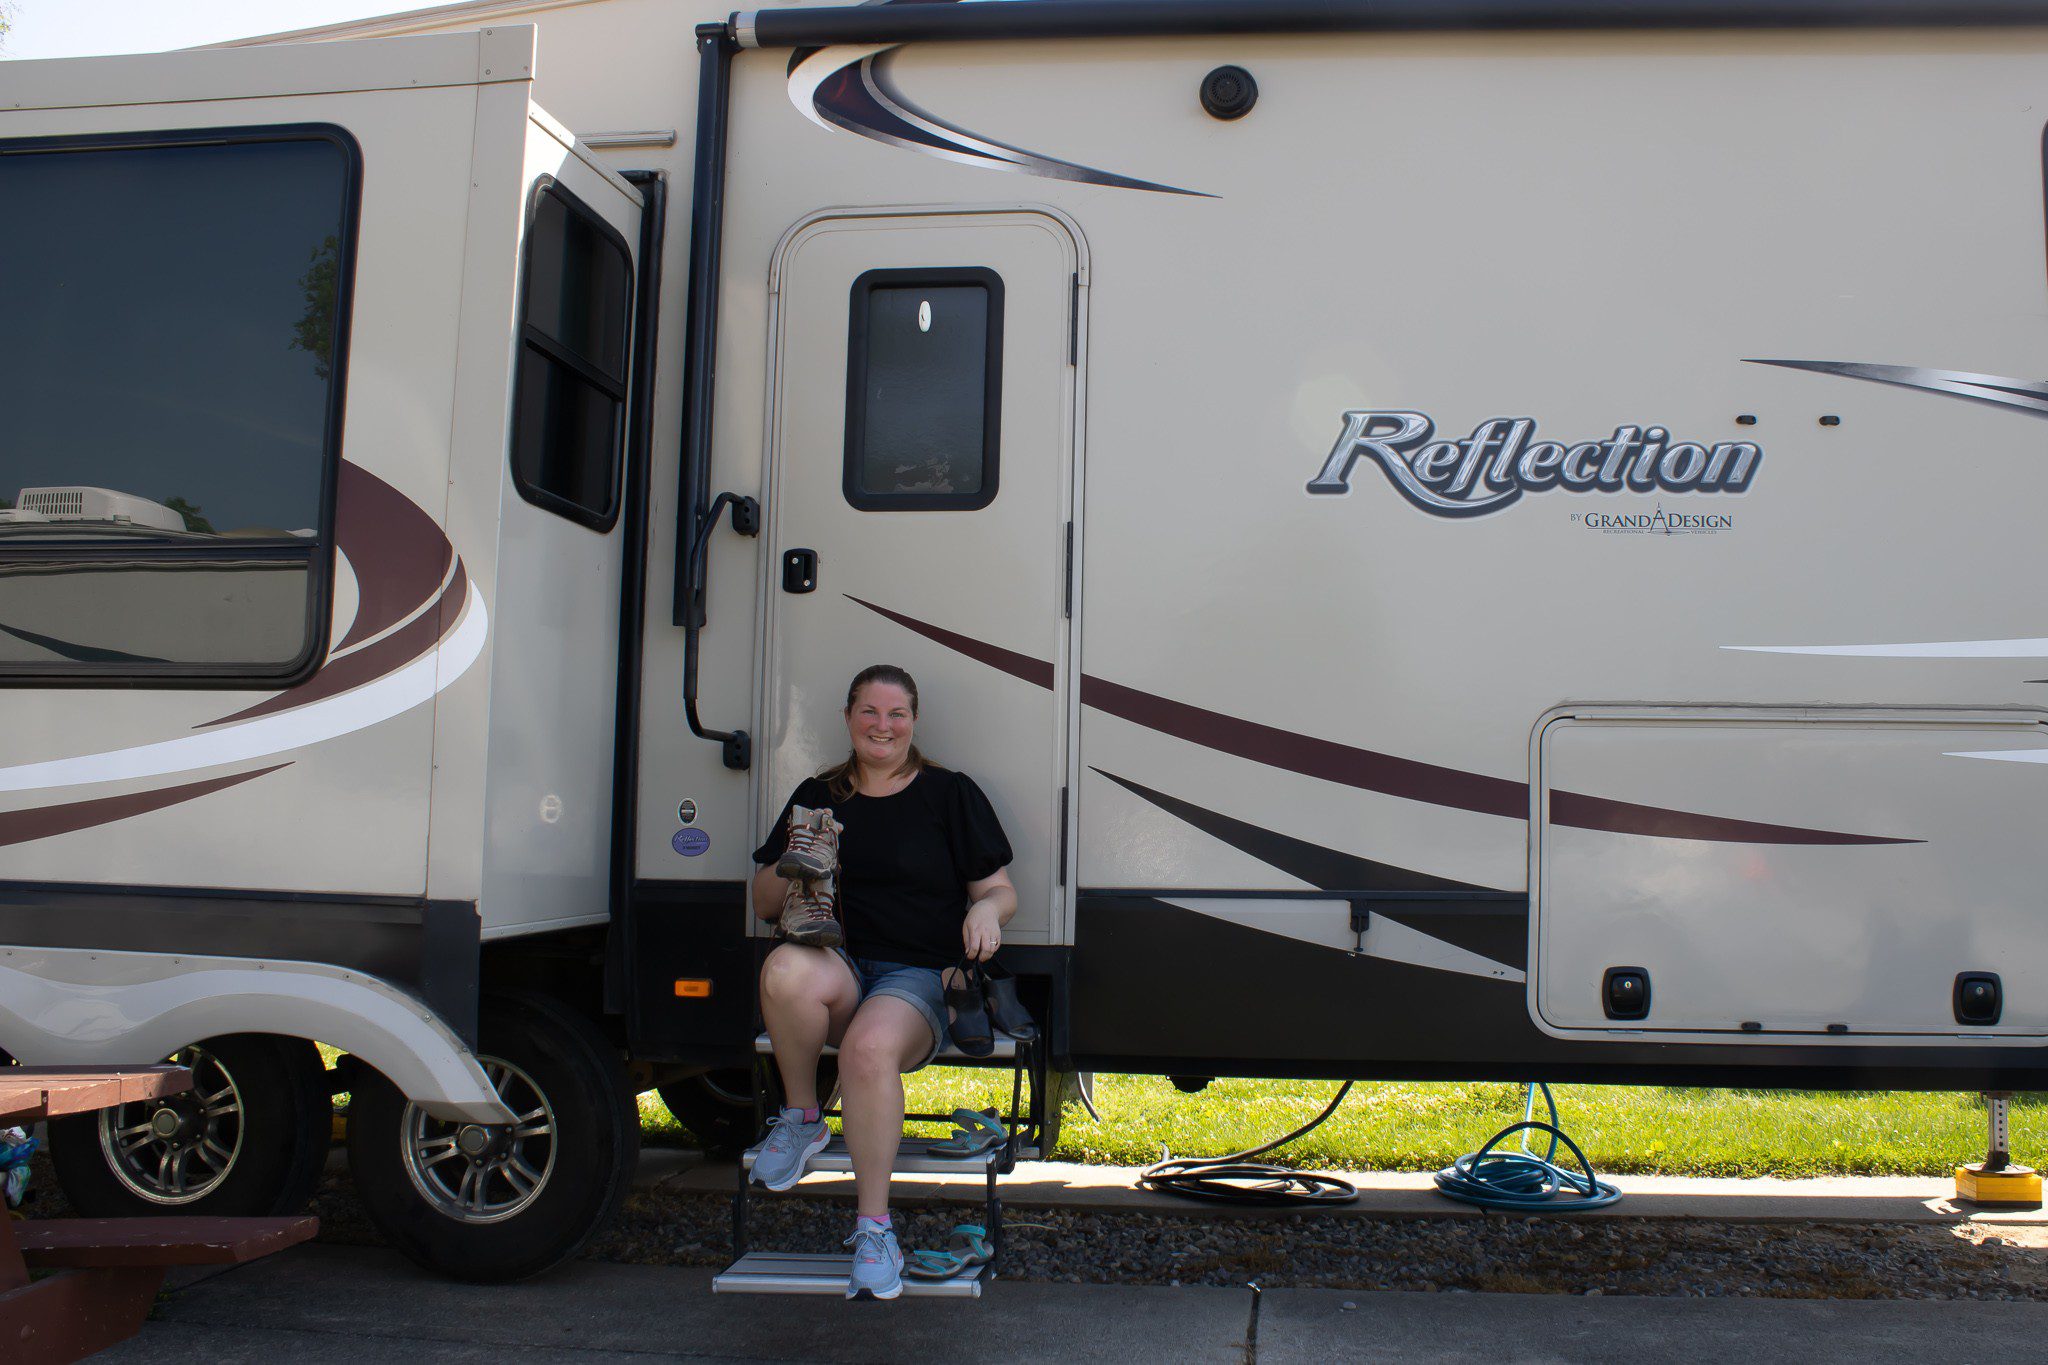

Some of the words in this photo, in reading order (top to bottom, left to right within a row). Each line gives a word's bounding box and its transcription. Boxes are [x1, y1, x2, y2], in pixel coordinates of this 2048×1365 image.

[1306, 409, 1763, 518] Reflection
[1570, 513, 1582, 522] BY
[1585, 512, 1650, 528] GRAND
[1668, 513, 1732, 528] DESIGN
